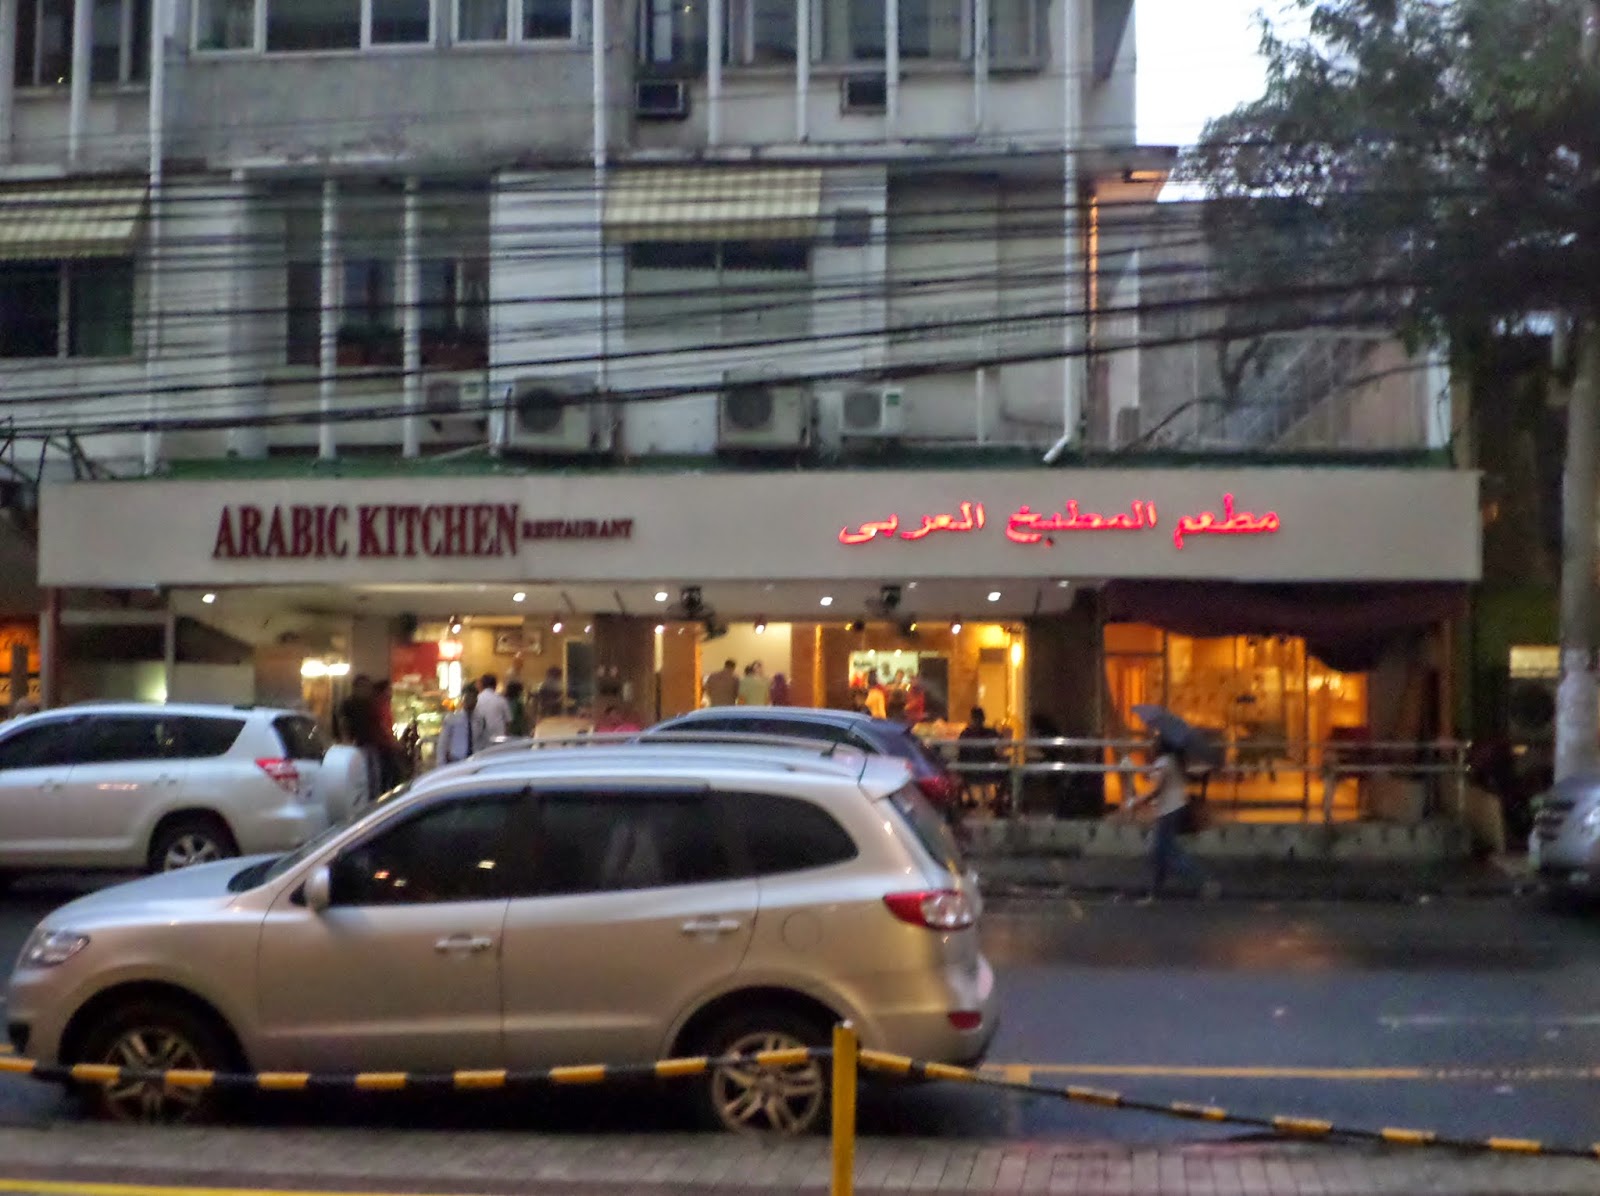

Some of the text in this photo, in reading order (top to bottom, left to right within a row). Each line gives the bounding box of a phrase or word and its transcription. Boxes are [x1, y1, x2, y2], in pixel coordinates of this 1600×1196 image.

[212, 504, 633, 558] ARABIC KITCHEN RESTAURANT
[1006, 499, 1157, 547] المطبخ
[1173, 493, 1280, 549] مطعم
